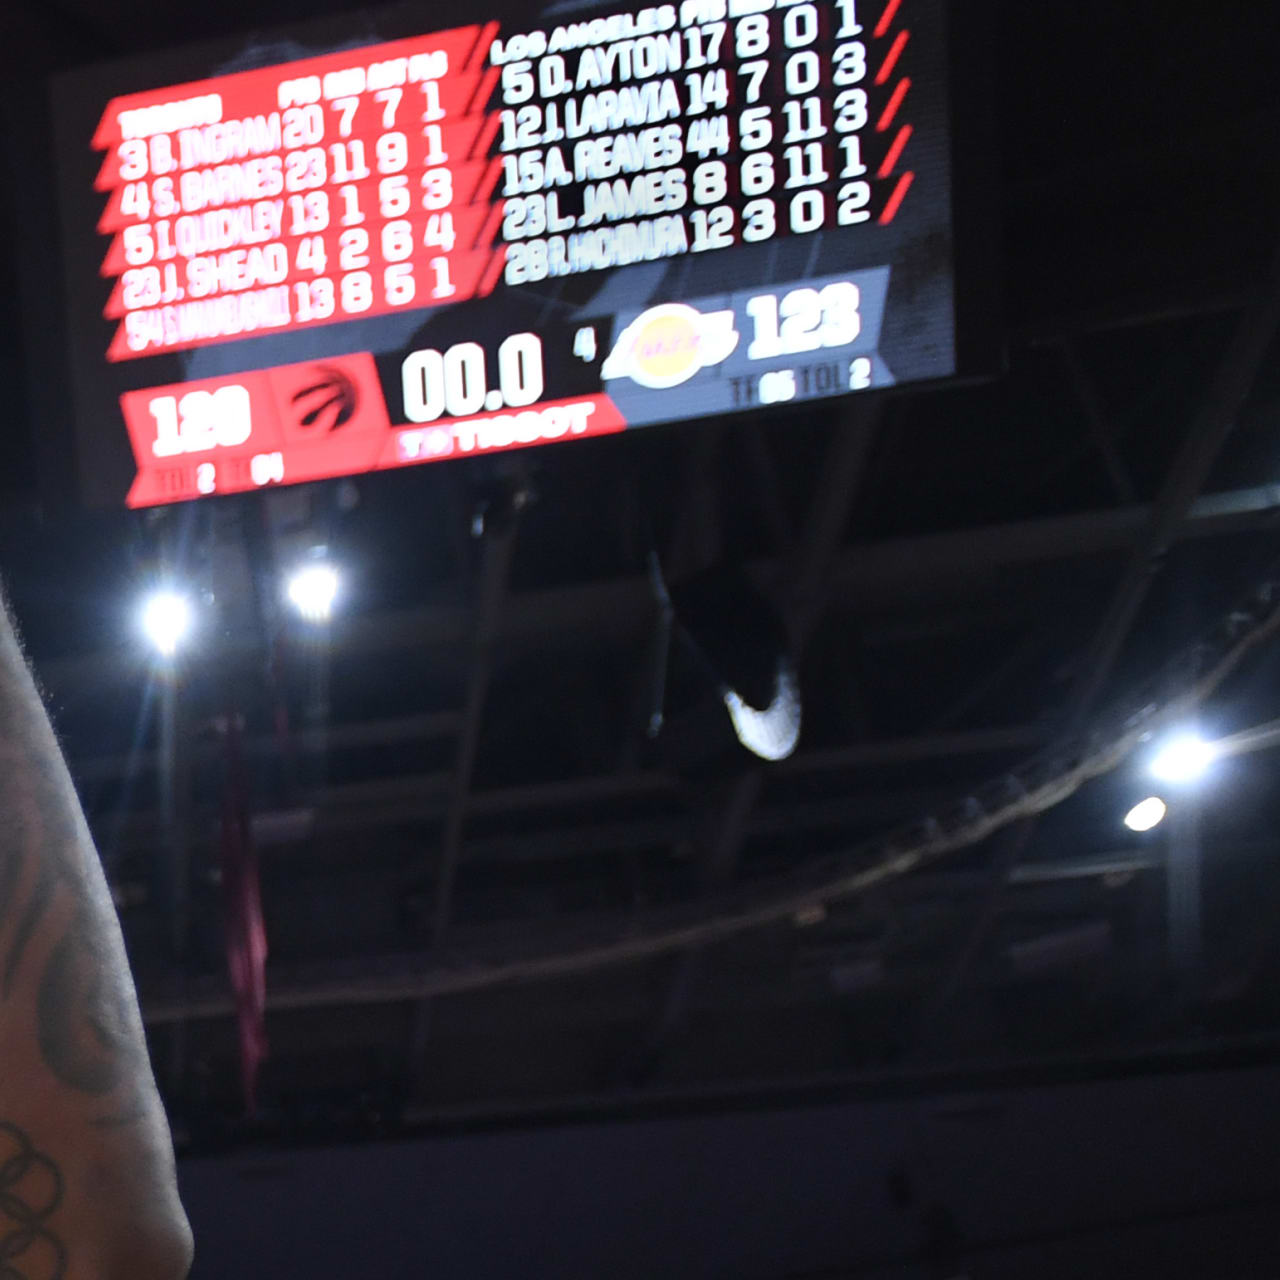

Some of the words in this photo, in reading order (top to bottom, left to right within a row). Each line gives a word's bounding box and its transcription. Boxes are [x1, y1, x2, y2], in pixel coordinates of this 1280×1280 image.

[499, 105, 543, 152] 12
[565, 78, 681, 138] LARAVIA
[684, 68, 730, 116] 14
[738, 60, 770, 102] 7
[785, 51, 819, 95] 0
[832, 41, 867, 86] 3
[502, 60, 534, 105] 5
[539, 54, 573, 99] D.
[575, 31, 682, 89] AYTON
[684, 22, 727, 69] 17
[736, 14, 770, 57] 8
[784, 4, 819, 49] 0
[835, 0, 863, 39] 1
[118, 139, 149, 180] 3
[178, 112, 282, 169] INGRAM
[282, 104, 324, 148] 20
[331, 96, 360, 137] 7
[374, 88, 403, 129] 7
[420, 80, 446, 122] 1
[120, 181, 150, 221] 4
[180, 155, 284, 212] BARNES
[285, 147, 327, 193] 23
[330, 139, 370, 184] 11
[376, 132, 408, 174] 9
[423, 124, 448, 166] 1
[501, 150, 545, 197] 15
[574, 124, 683, 182] REAVES
[685, 115, 731, 159] 44
[739, 106, 773, 151] 5
[782, 97, 828, 144] 11
[833, 88, 868, 133] 3
[123, 223, 155, 265] 5
[288, 190, 330, 236] 13
[340, 184, 365, 226] 1
[379, 175, 411, 218] 5
[421, 167, 453, 210] 3
[502, 194, 546, 242] 23
[576, 168, 687, 227] JAMES
[693, 161, 728, 206] 8
[741, 152, 775, 197] 6
[783, 142, 829, 189] 11
[838, 135, 868, 179] 1
[504, 239, 549, 287] 28
[689, 206, 735, 253] 12
[742, 198, 776, 244] 3
[790, 189, 825, 235] 0
[837, 181, 871, 226] 2
[122, 266, 161, 310] 23
[186, 242, 289, 299] SHEAD
[296, 235, 328, 276] 4
[339, 227, 370, 271] 2
[381, 220, 414, 262] 6
[423, 211, 456, 252] 4
[294, 276, 335, 323] 13
[340, 270, 373, 313] 8
[383, 262, 416, 306] 5
[430, 256, 456, 299] 1
[746, 281, 861, 361] 123
[402, 332, 544, 424] 00.0
[849, 357, 872, 391] 2
